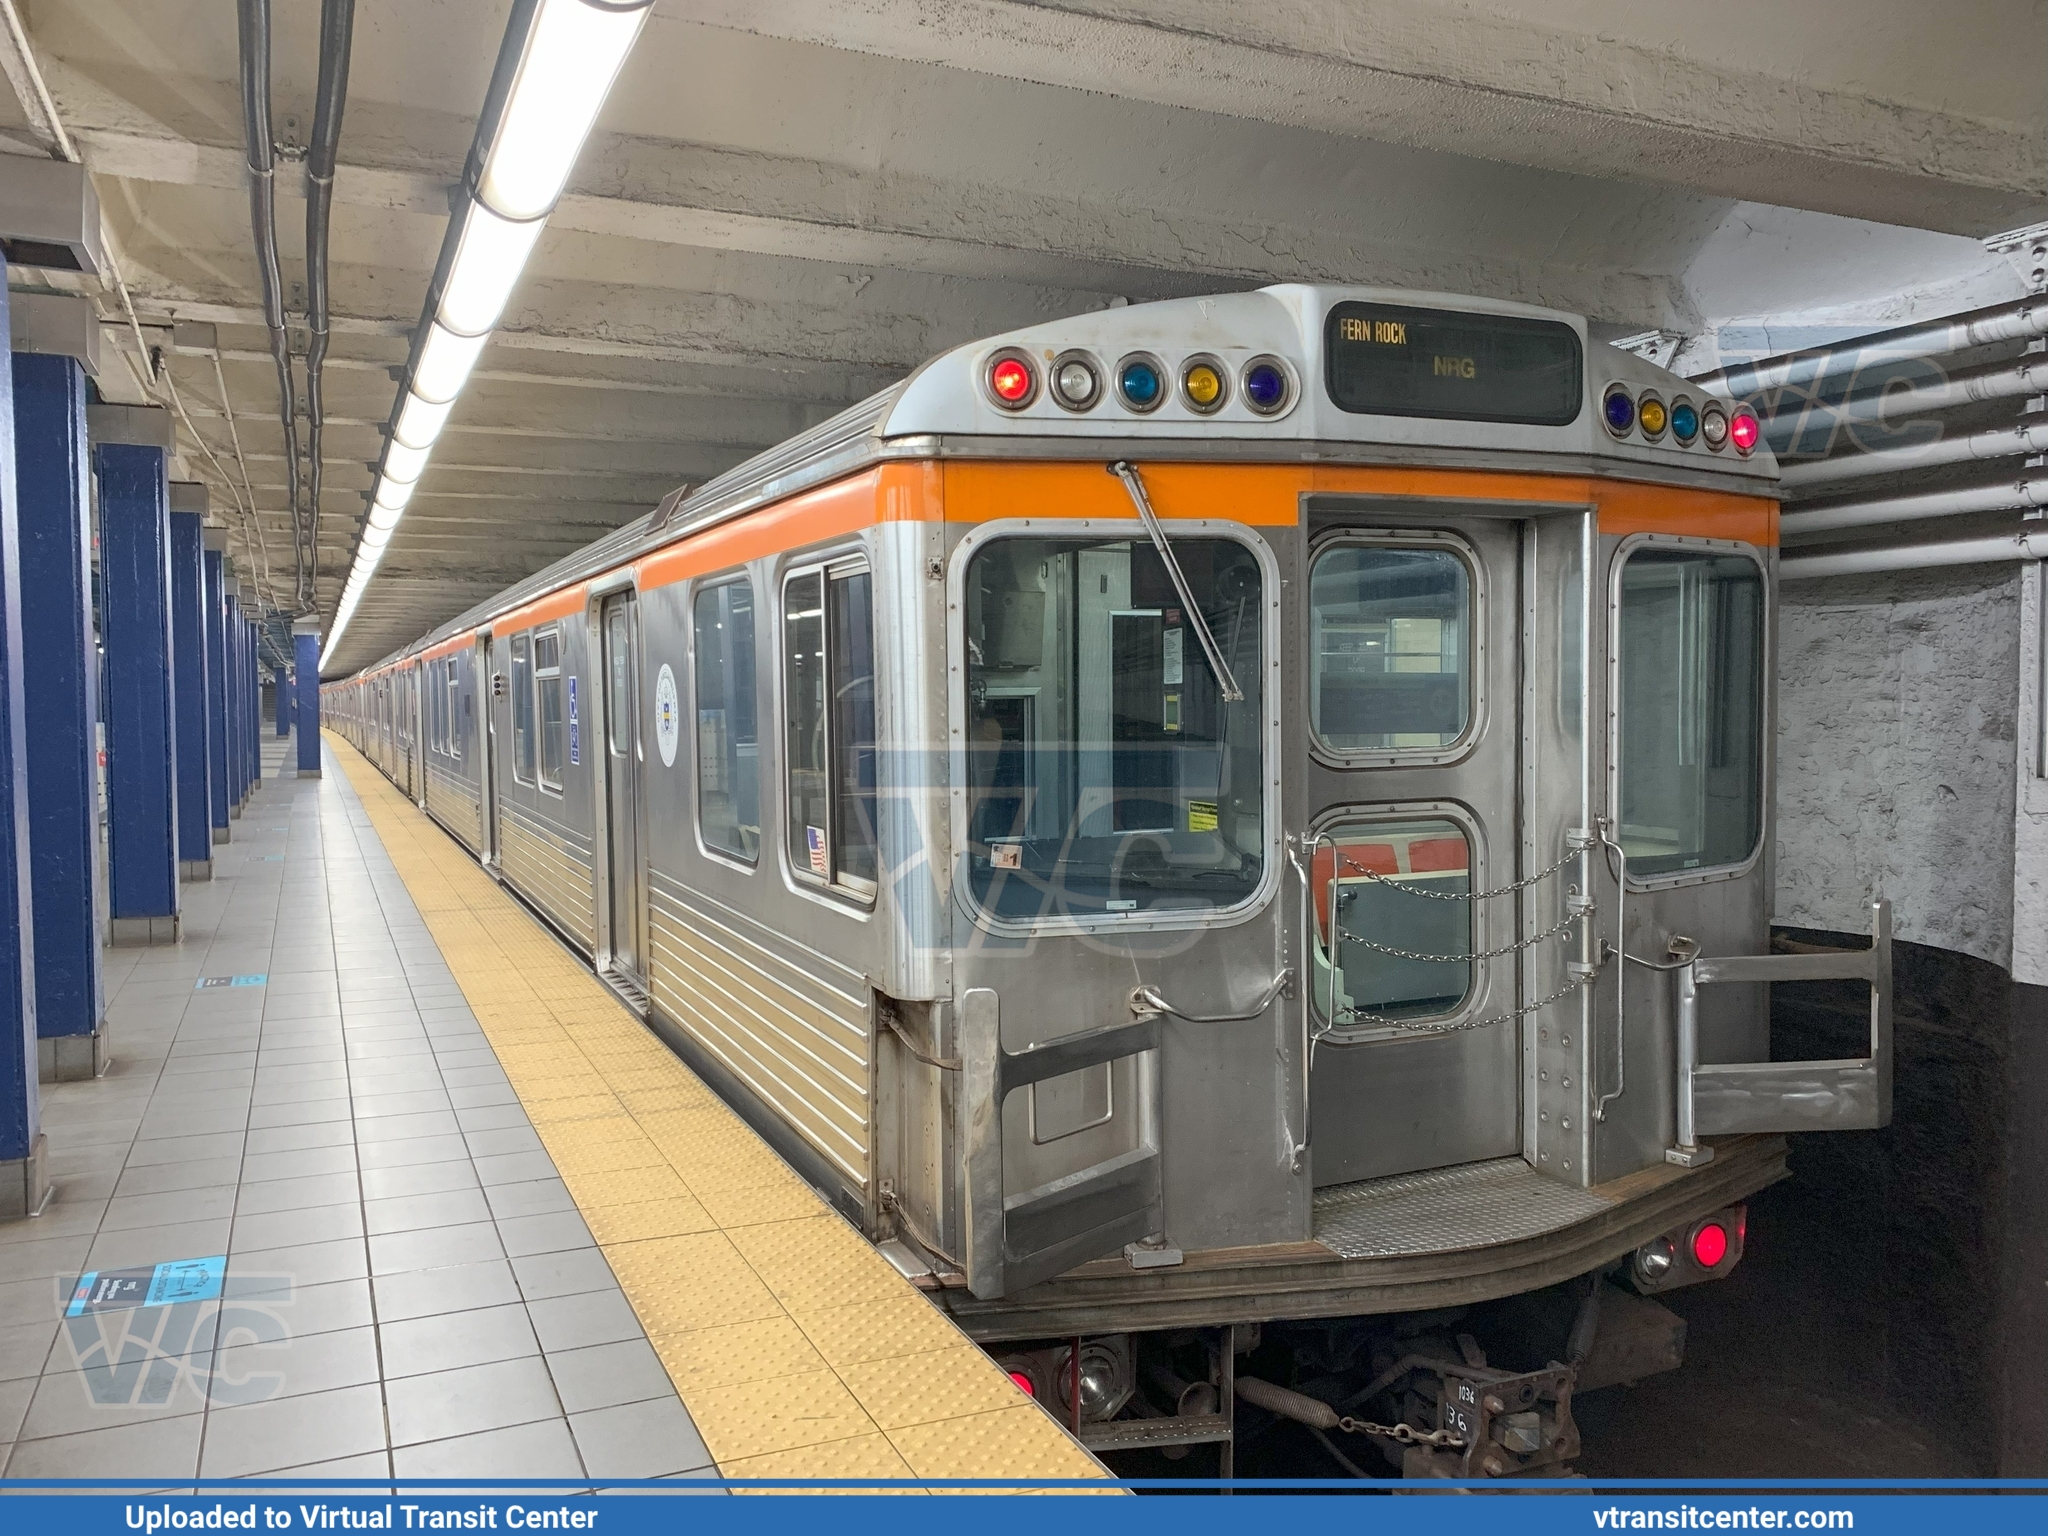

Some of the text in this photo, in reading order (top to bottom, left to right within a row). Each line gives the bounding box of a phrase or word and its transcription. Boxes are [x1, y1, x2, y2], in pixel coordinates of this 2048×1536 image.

[1340, 318, 1407, 345] FERN ROCK
[1433, 355, 1476, 379] NRG
[1459, 1386, 1475, 1404] 1036
